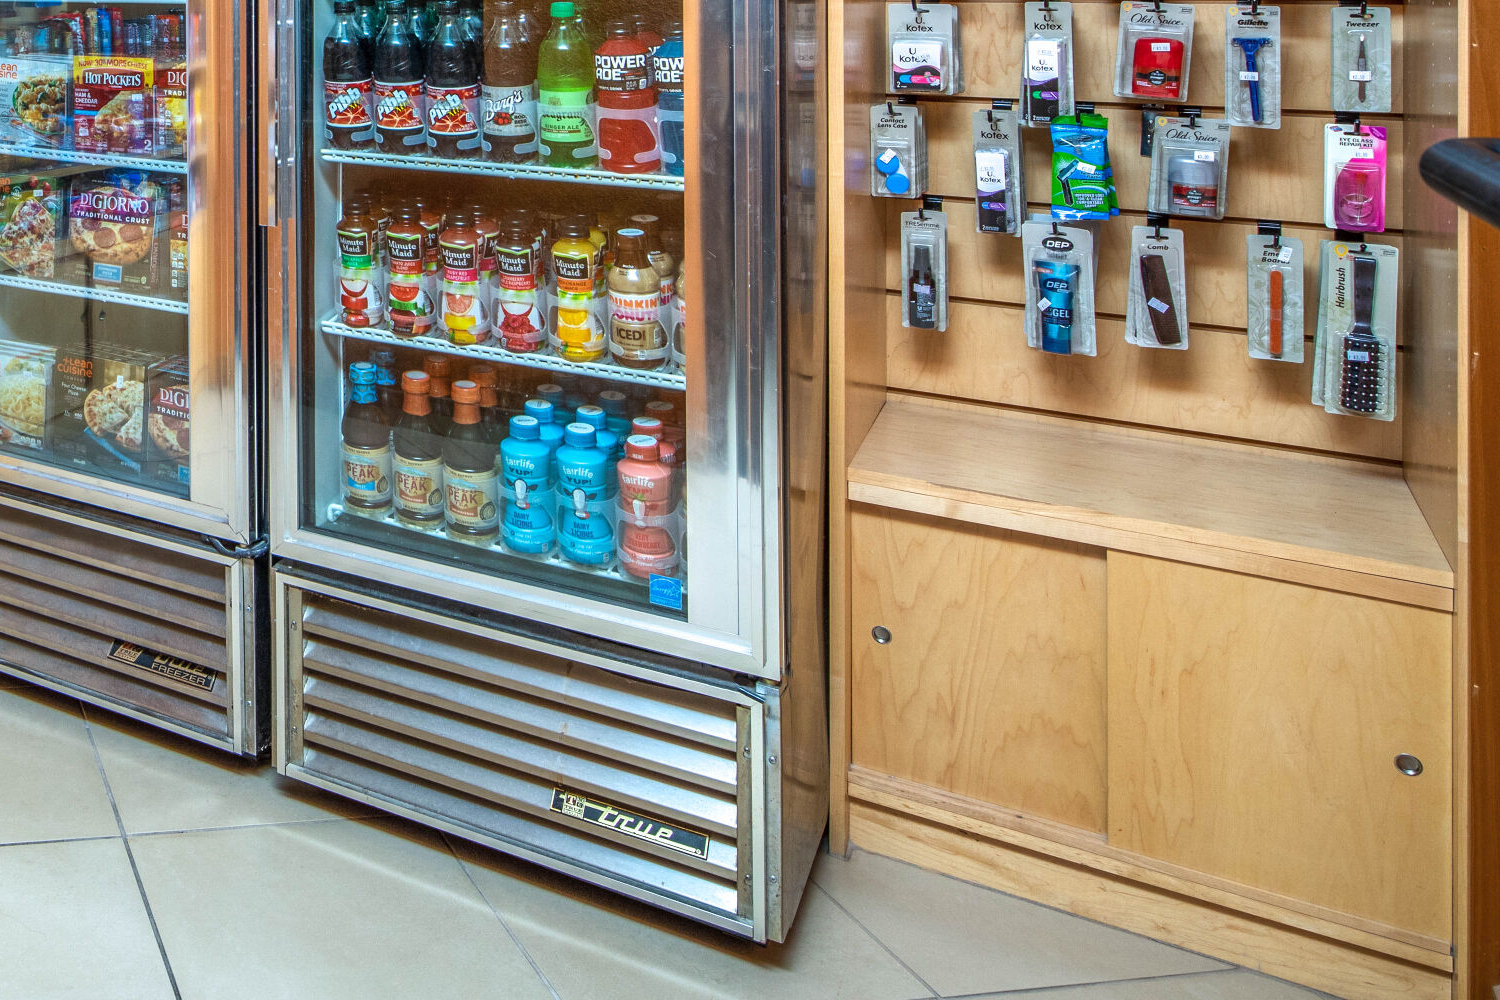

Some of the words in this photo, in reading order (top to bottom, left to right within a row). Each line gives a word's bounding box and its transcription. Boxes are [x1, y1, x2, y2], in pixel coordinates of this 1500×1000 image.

[1130, 12, 1154, 26] Old
[1156, 14, 1182, 26] Spice
[1237, 18, 1268, 27] Gillette
[1346, 20, 1380, 28] Tweezer
[594, 54, 646, 68] POWER
[85, 72, 101, 84] HOT
[103, 72, 141, 86] POCKETS
[595, 68, 621, 82] ADE
[486, 90, 523, 122] Barq's
[1191, 132, 1218, 143] Spice
[80, 193, 149, 214] DIGIORNO
[77, 210, 123, 222] TRADITIONAL
[125, 216, 150, 225] CRUST
[388, 240, 416, 250] Minute
[1047, 240, 1069, 249] DEP
[392, 249, 412, 257] Maid
[443, 249, 471, 259] Minute
[446, 258, 466, 266] Maid
[556, 259, 584, 269] Minute
[560, 268, 580, 277] Maid
[1047, 280, 1069, 289] DEP
[1335, 267, 1346, 309] Hairbrush
[1052, 309, 1070, 318] GEL
[505, 455, 535, 470] fairlife
[348, 466, 375, 480] PEAK
[562, 465, 594, 479] fairlife
[398, 477, 428, 492] PEAK
[621, 474, 655, 489] fairlife
[449, 489, 478, 504] PEAK
[151, 663, 206, 685] FREEZER
